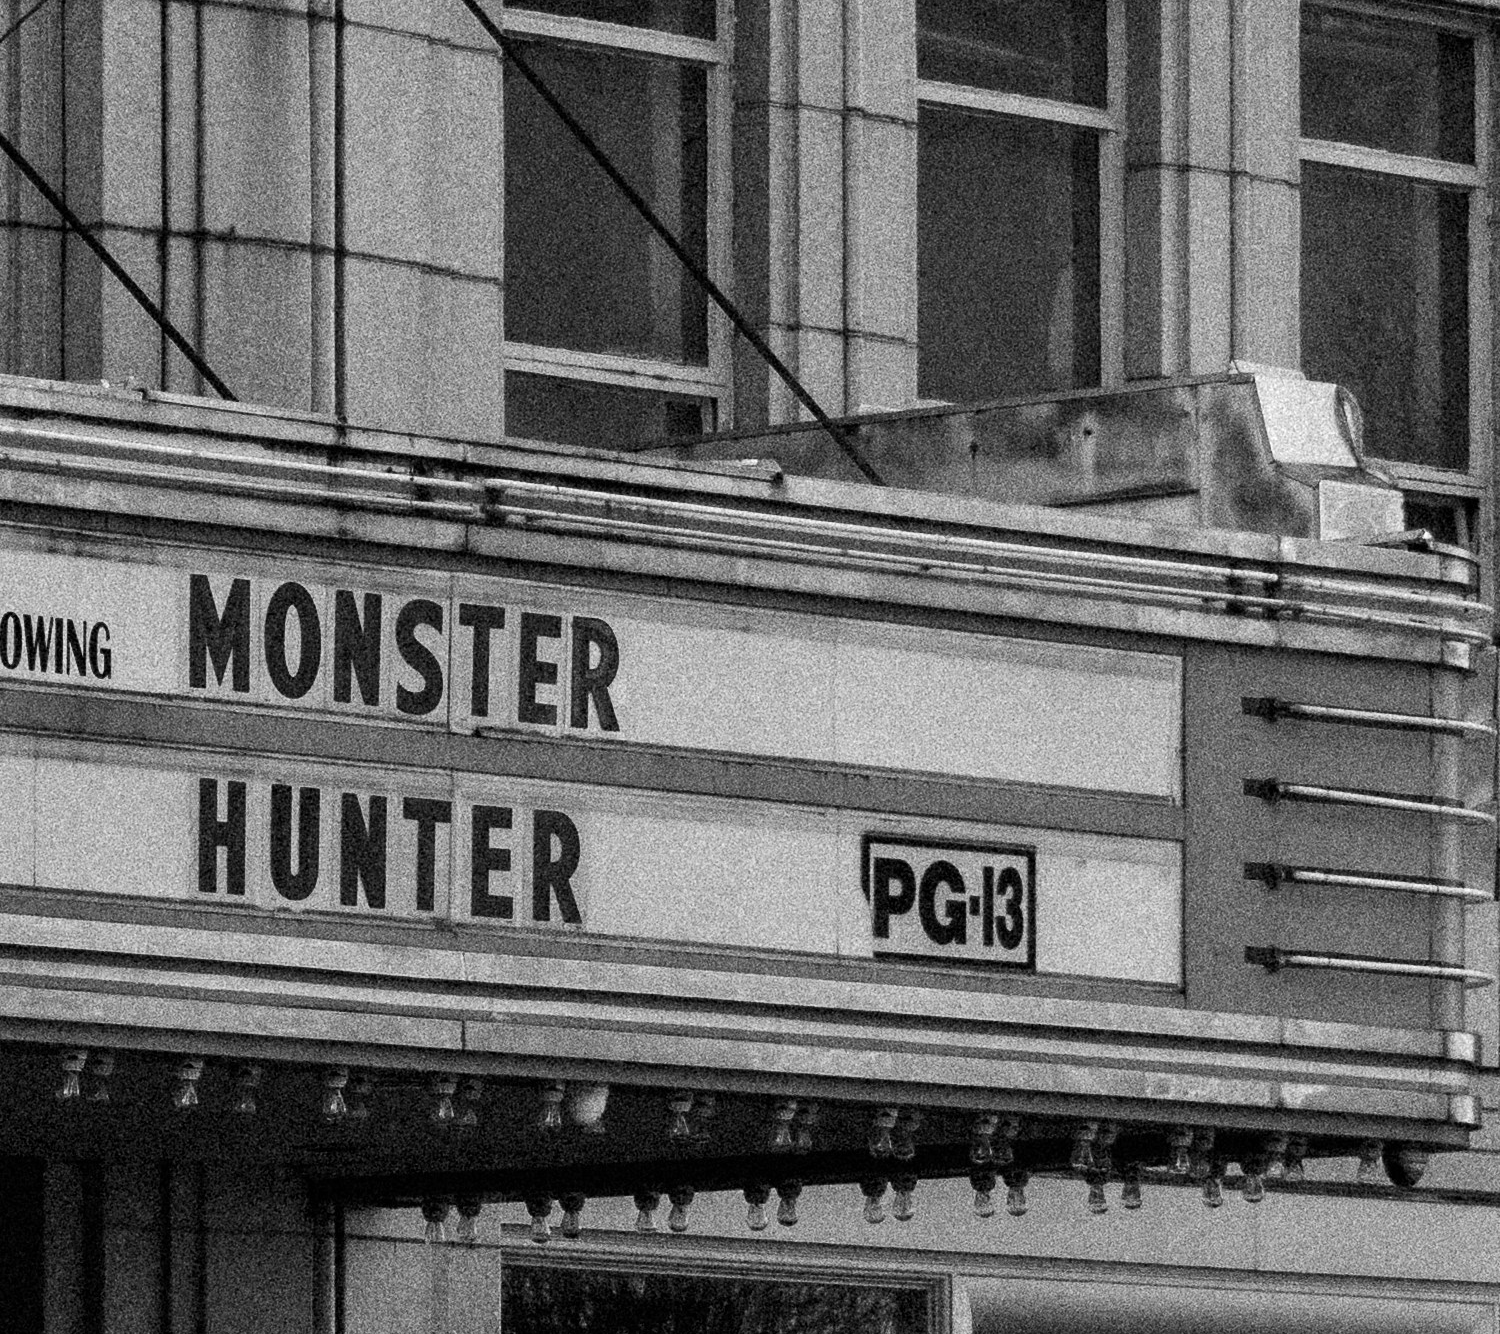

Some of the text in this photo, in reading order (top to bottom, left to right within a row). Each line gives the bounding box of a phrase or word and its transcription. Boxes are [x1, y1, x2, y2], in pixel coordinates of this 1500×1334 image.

[188, 573, 622, 732] MONSTER
[199, 777, 583, 925] HUNTER
[873, 857, 1026, 951] PG-13
